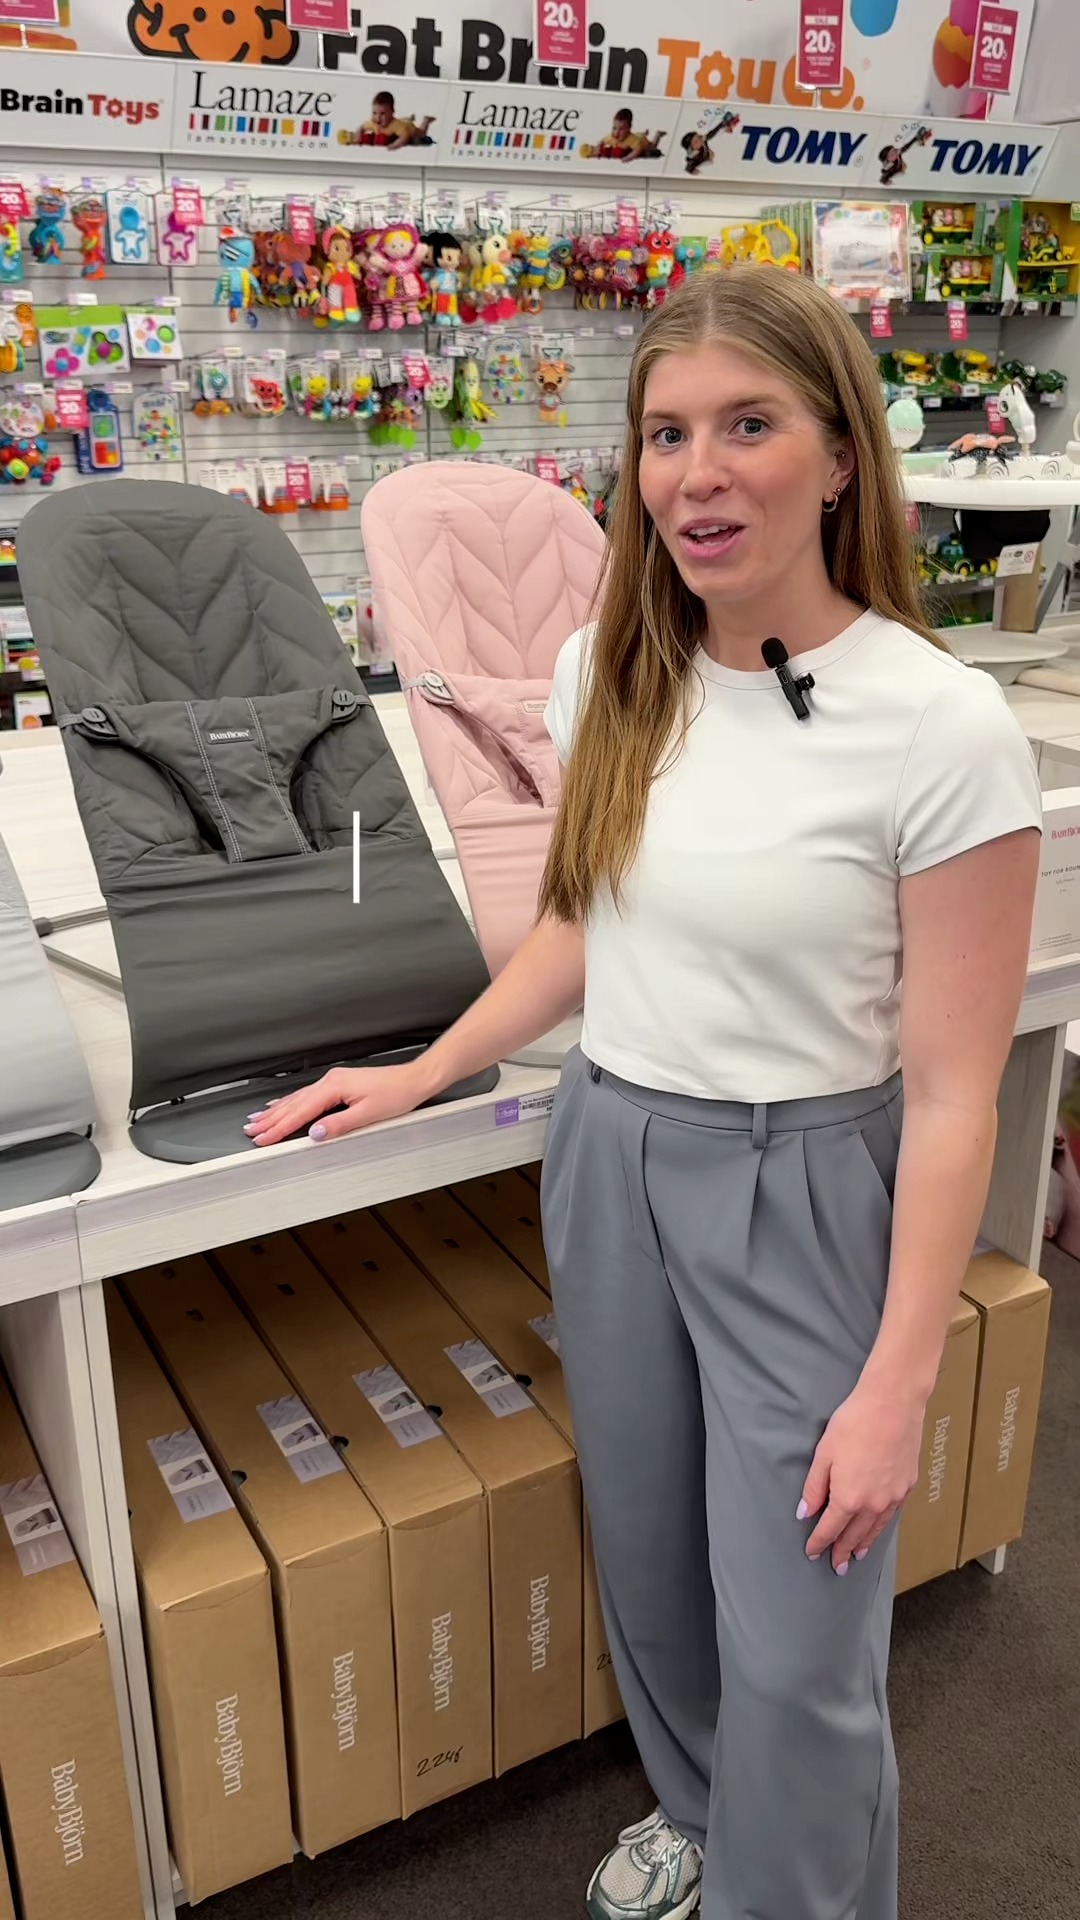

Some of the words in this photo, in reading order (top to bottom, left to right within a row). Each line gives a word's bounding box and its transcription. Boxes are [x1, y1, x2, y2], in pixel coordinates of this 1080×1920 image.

[0, 89, 83, 115] Brain
[87, 94, 160, 125] Toys
[190, 70, 334, 116] Lamaze
[457, 90, 580, 132] Lamaze
[187, 134, 329, 149] lamazetoys.com
[741, 125, 867, 165] TOMY
[930, 138, 1043, 176] TOMY
[928, 1415, 950, 1503] BabyBjörn
[998, 1386, 1020, 1472] BabyBjörn
[429, 1612, 453, 1713] BabyBjörn
[528, 1574, 550, 1673] BabyBjörn
[331, 1650, 358, 1752] BabyBjörn
[214, 1693, 244, 1797] BabyBjörn
[51, 1758, 86, 1865] BabyBjörn
